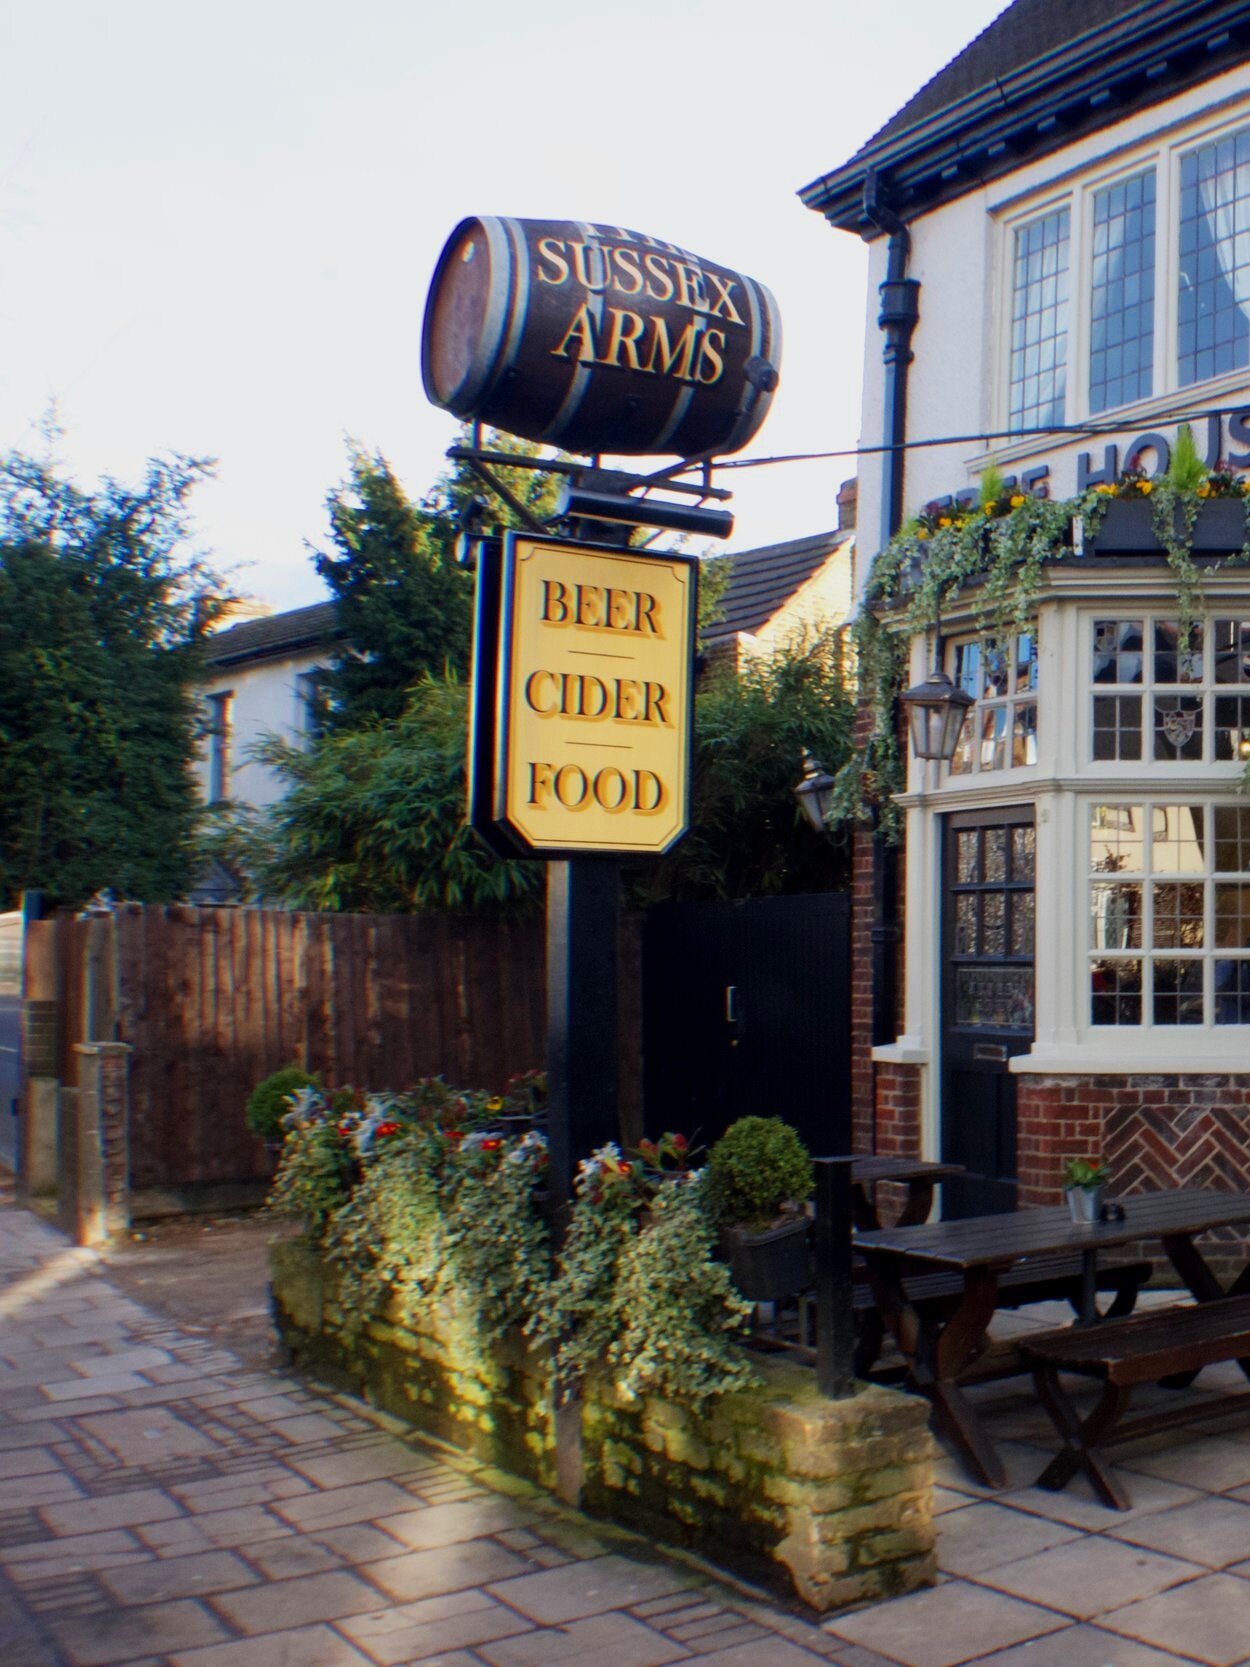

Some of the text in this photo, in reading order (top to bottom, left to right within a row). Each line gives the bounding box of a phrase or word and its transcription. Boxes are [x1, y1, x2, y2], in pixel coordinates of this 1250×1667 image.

[537, 236, 746, 327] SUSSEX
[550, 302, 726, 385] ARMS
[541, 579, 660, 636] BEER
[525, 669, 671, 725] CIDER
[527, 761, 665, 813] FOOD
